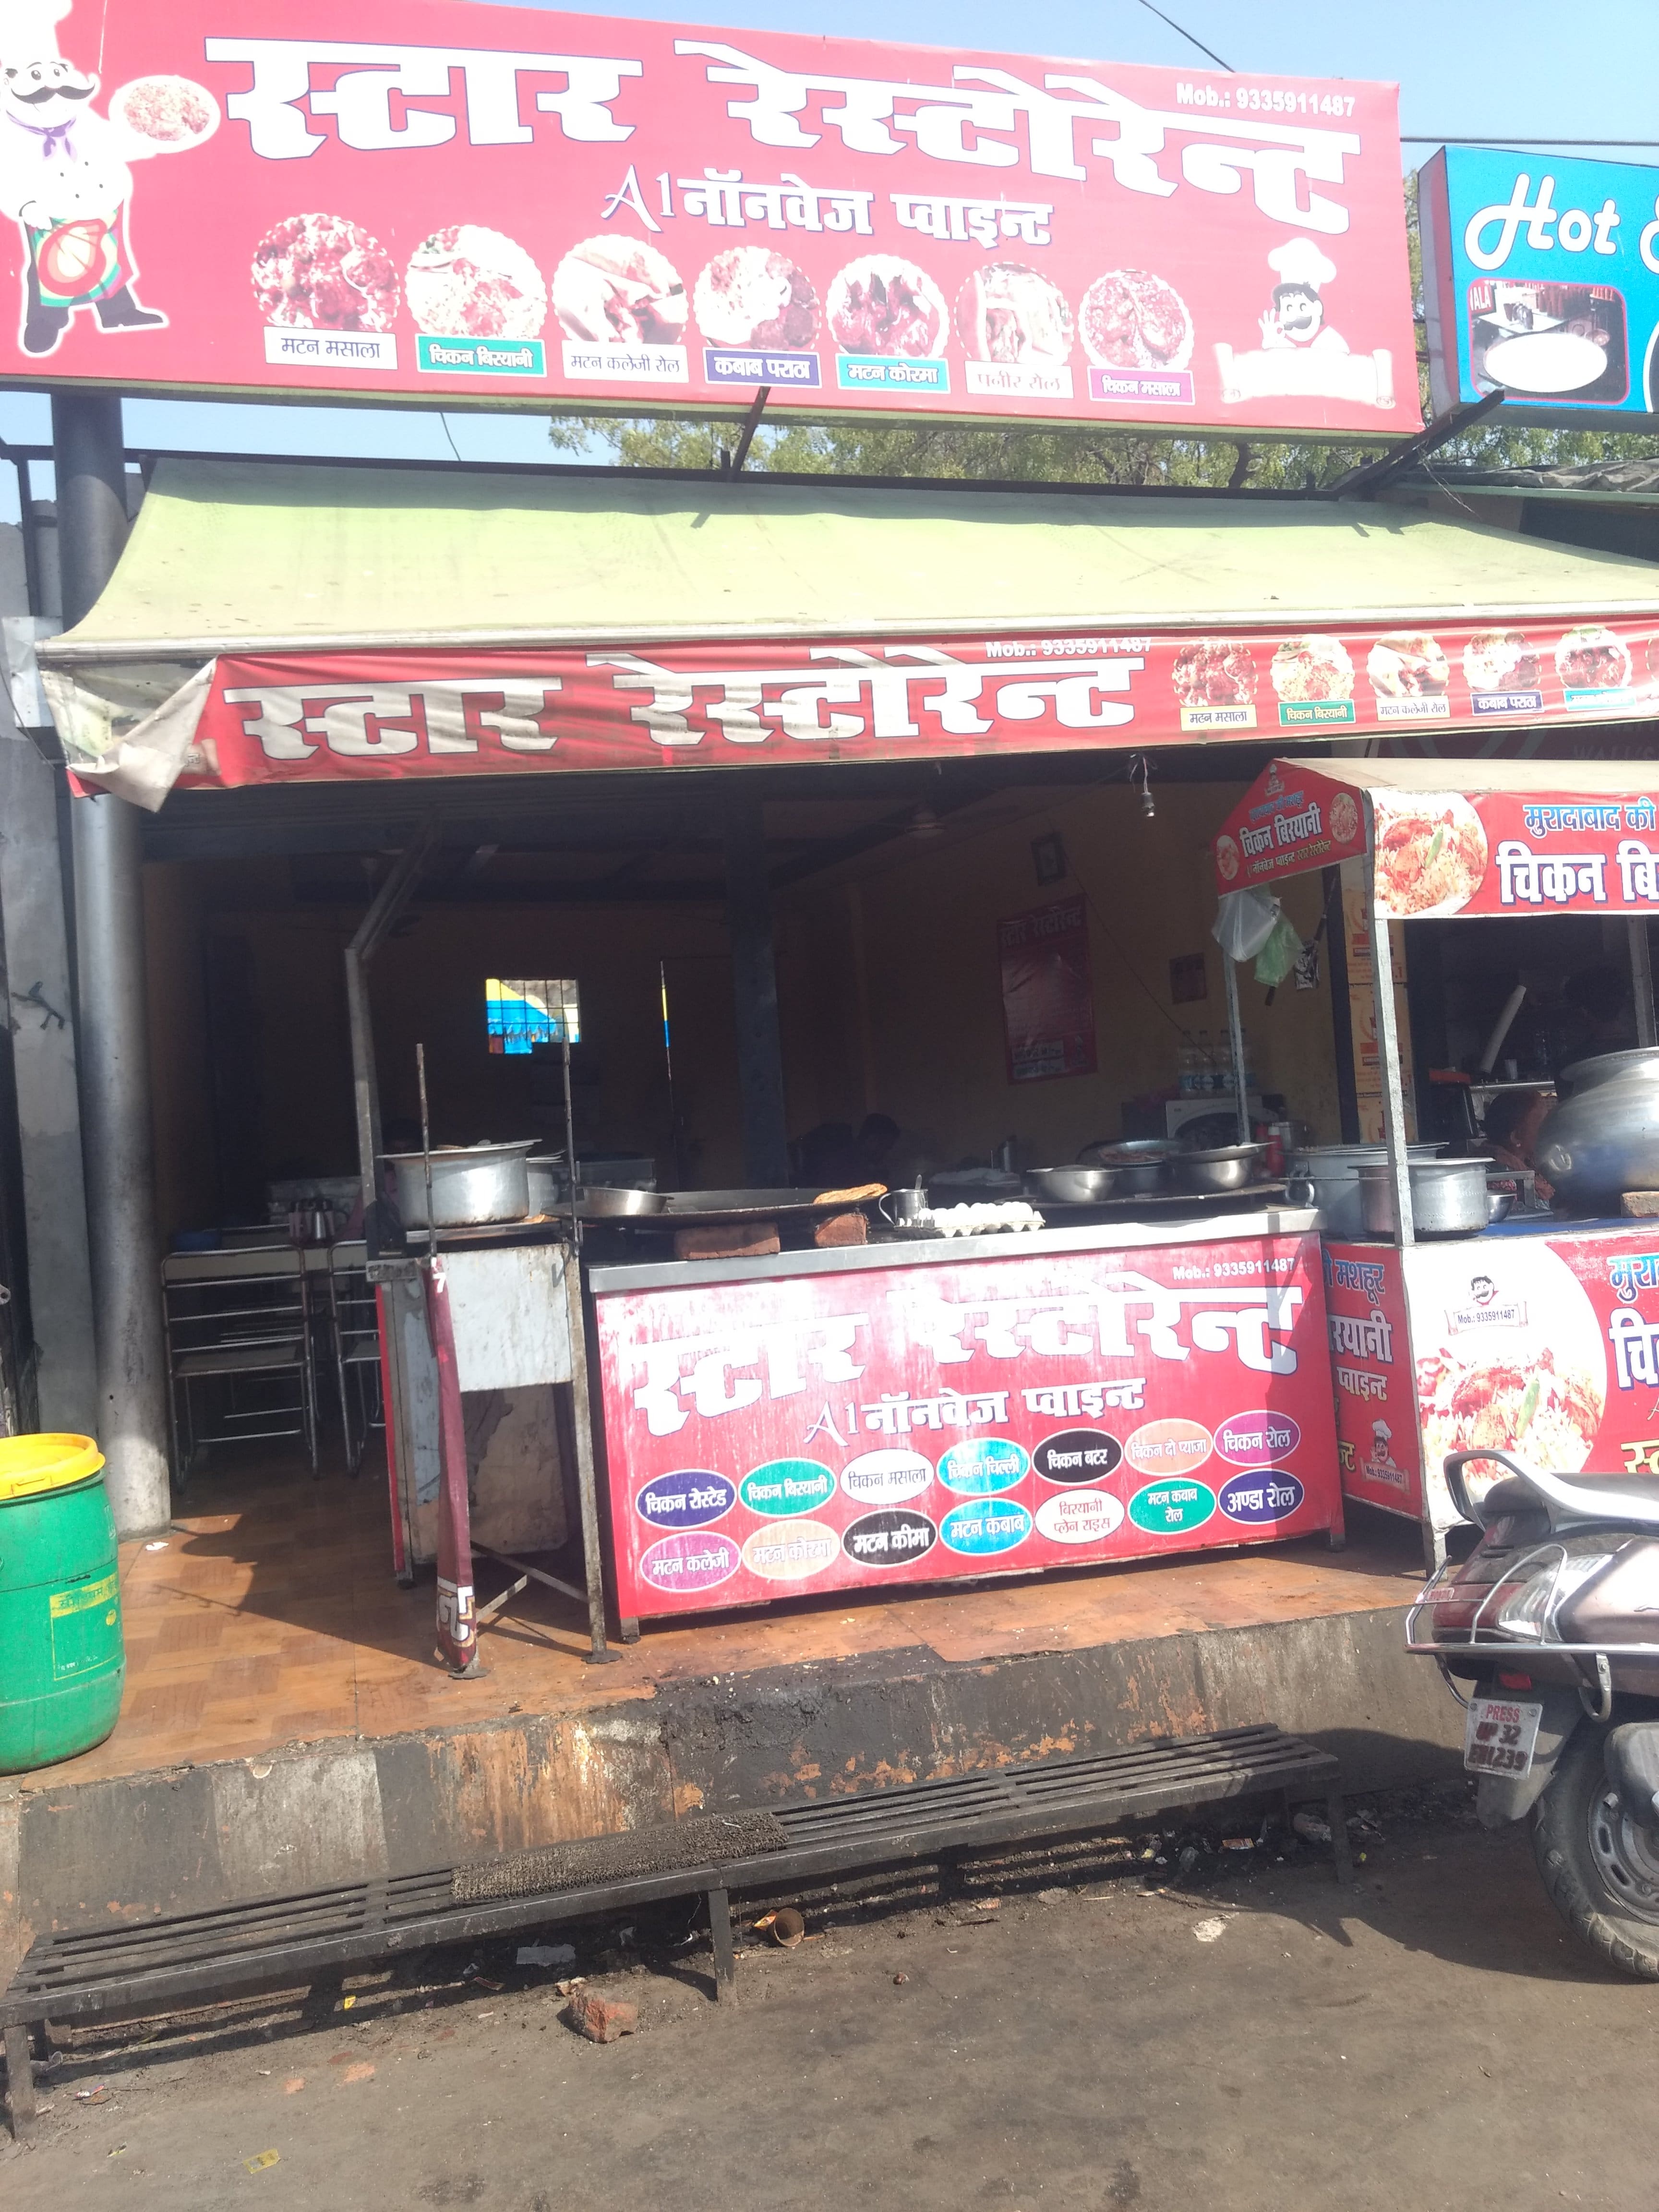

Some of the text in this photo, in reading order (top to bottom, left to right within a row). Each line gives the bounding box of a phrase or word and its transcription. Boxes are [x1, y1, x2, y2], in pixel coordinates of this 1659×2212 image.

[1176, 82, 1355, 117] Mob.: 9335911487
[204, 36, 1361, 235] स्टार रेस्टोरेन्ट
[890, 193, 1055, 250] प्वाइन्ट
[1464, 173, 1621, 271] Hot
[281, 337, 380, 359] मटन मसाला
[429, 343, 475, 365] चिकन
[571, 354, 680, 373] मटन कलेजी रोल
[714, 356, 763, 377] कबाब
[848, 362, 938, 384] मटन कोरमा
[978, 370, 1021, 388] पनीर
[1102, 374, 1181, 397] चिकन मसाला
[985, 637, 1152, 658] Mob.: 9335911487
[223, 645, 1146, 761] स्टार रेस्टोरेन्ट
[1286, 707, 1313, 721] चिकन
[1380, 701, 1446, 715] मटन कलेजी रोल
[1477, 698, 1508, 710] कबाब
[1190, 710, 1247, 724] मटन मसाला
[1523, 796, 1657, 839] मुरादाबाद की
[1239, 802, 1322, 858] चिकन बिरयानी
[1495, 839, 1659, 905] चिकन बि
[1172, 1258, 1295, 1280] Mob.: 9335911487
[1606, 1253, 1659, 1304] मुरा
[1334, 1259, 1385, 1306] मशहूर
[1458, 1309, 1514, 1324] Mob.: 9335911487
[1327, 1310, 1392, 1362] रयानी
[624, 1270, 1302, 1437] स्टार रेस्टोरेन्ट
[1609, 1307, 1659, 1391] चि
[1336, 1367, 1388, 1402] प्वाइन्ट
[1022, 1377, 1147, 1419] प्वाइन्ट
[1131, 1438, 1207, 1460] चिकन दो प्याजा
[1223, 1426, 1291, 1453] चिकन रोल
[948, 1453, 1020, 1479] चिकन चिल्ली
[1047, 1449, 1108, 1470] चिकन बटर
[848, 1469, 926, 1489] चिकन मसाला
[1378, 1468, 1402, 1484] 9335911487
[646, 1486, 727, 1515] चिकन रोस्टेड
[747, 1482, 782, 1501] चिकन
[1147, 1491, 1170, 1505] मटन
[1227, 1482, 1296, 1513] अण्डा रोल
[1054, 1517, 1110, 1534] प्लेन राइस
[1165, 1507, 1183, 1523] रोल
[950, 1514, 1025, 1539] मटन कबाब
[853, 1524, 930, 1554] मटन कीमा
[652, 1547, 730, 1576] मटन कलेजी
[752, 1545, 785, 1564] मटन
[1486, 1705, 1520, 1723] PRESS
[1499, 1724, 1521, 1746] 32
